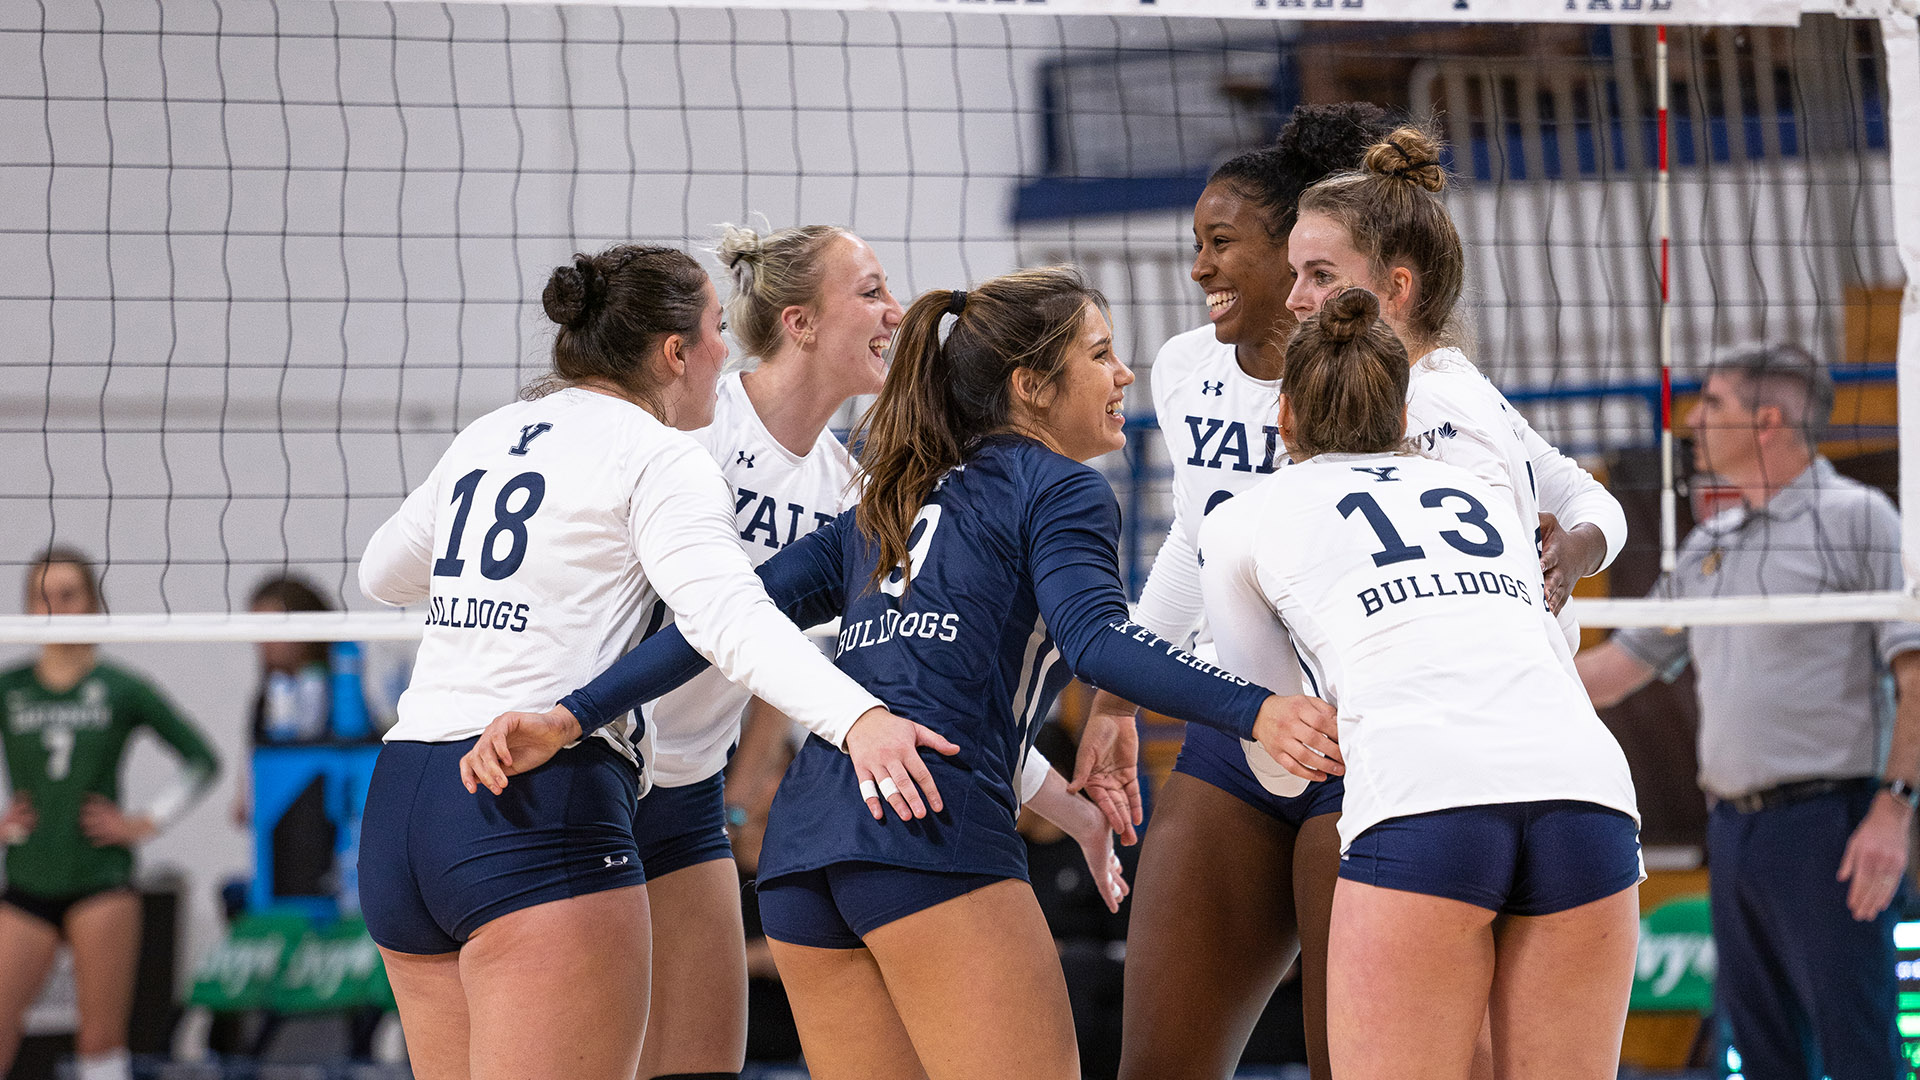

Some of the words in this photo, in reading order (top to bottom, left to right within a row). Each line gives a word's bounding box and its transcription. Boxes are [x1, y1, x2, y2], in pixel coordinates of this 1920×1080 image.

[508, 422, 553, 457] Y
[1184, 415, 1295, 475] YAL
[1351, 466, 1402, 482] Y
[433, 468, 546, 581] 18
[736, 487, 837, 549] AL
[1335, 488, 1504, 568] 13
[880, 504, 942, 597] 9
[425, 596, 530, 632] ULLDOGS
[1357, 571, 1532, 618] BULLDOGS
[835, 608, 960, 660] BULLDOGS
